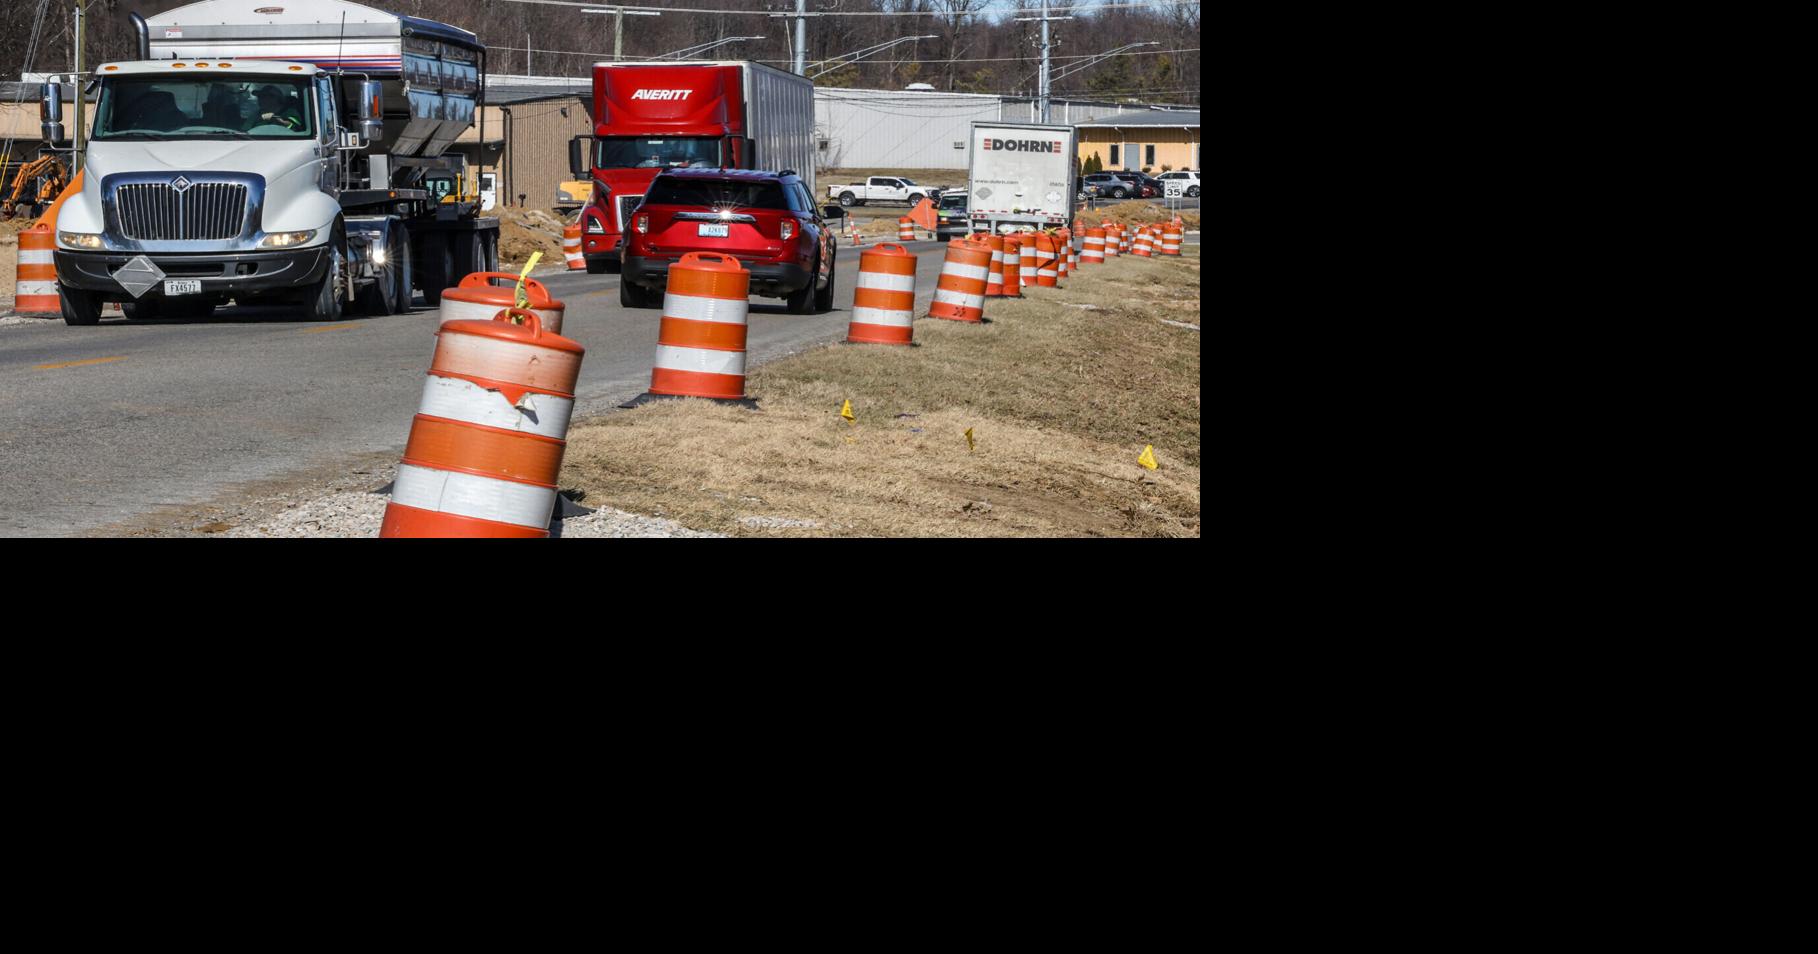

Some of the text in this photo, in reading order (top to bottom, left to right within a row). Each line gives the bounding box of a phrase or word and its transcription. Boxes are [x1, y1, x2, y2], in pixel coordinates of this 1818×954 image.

[631, 89, 693, 100] AVERITT
[992, 139, 1053, 153] DOHRN
[1167, 188, 1181, 196] 35
